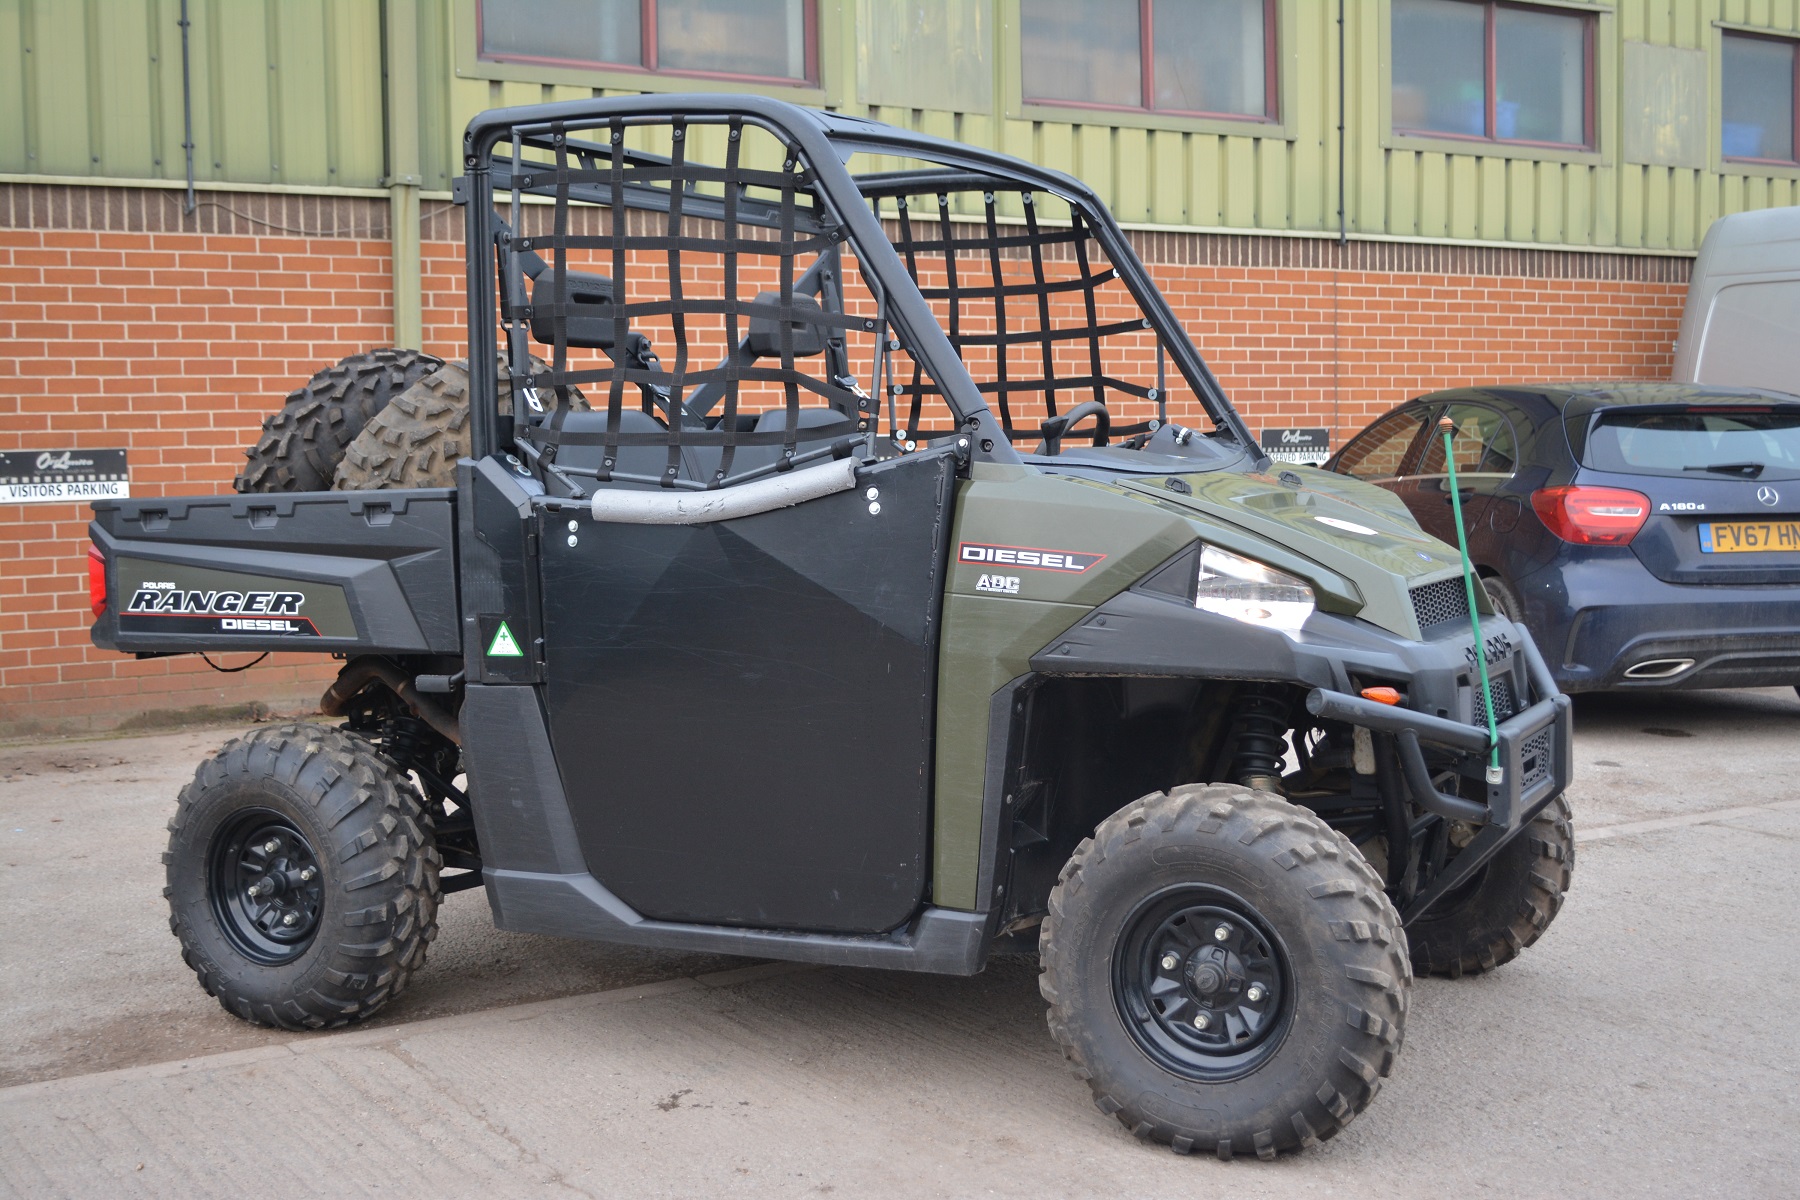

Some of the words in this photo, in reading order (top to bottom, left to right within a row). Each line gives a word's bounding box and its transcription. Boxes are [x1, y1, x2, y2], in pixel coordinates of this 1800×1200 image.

[1299, 451, 1326, 461] PARKING
[9, 484, 62, 498] VISITORS
[67, 483, 118, 496] PARKING
[1715, 525, 1770, 547] FV67
[962, 547, 1085, 570] DIESEL
[142, 582, 176, 590] POLARIS
[976, 574, 1020, 590] ADC
[128, 590, 304, 615] RANGER
[221, 618, 299, 632] DIESEL
